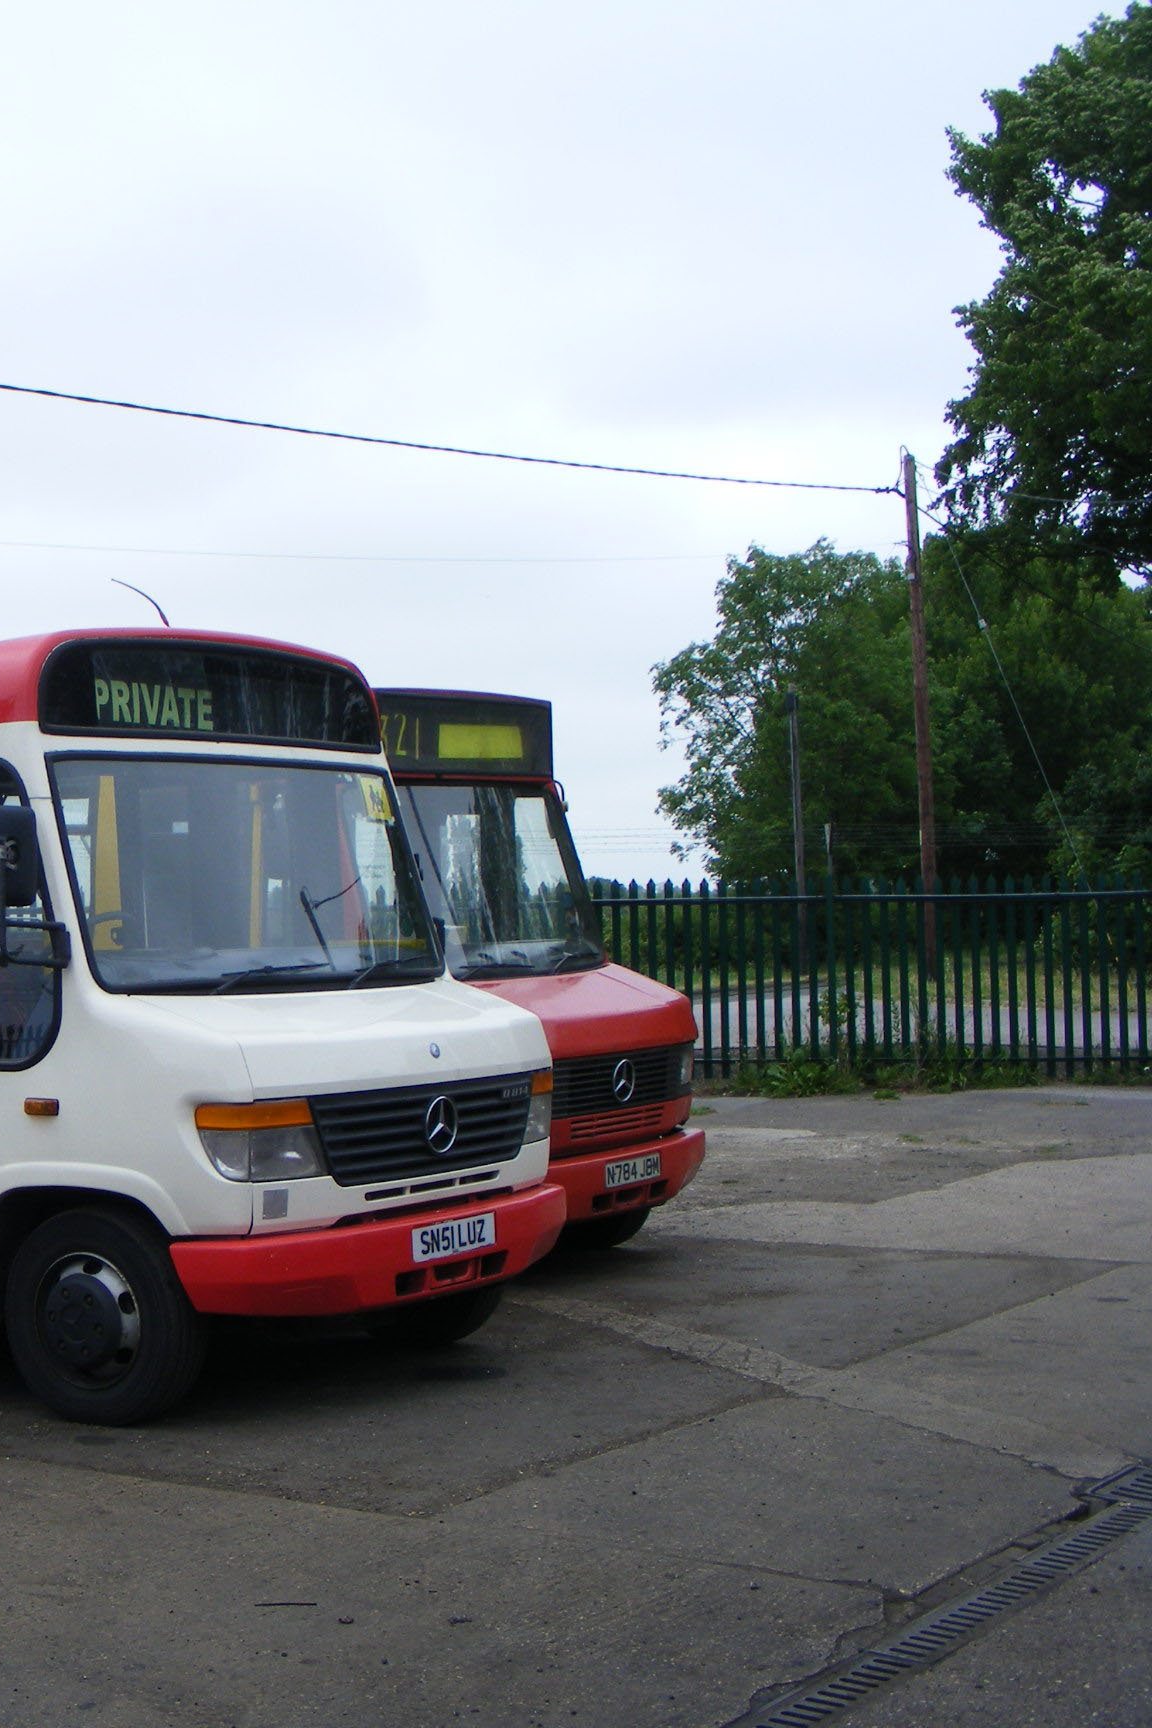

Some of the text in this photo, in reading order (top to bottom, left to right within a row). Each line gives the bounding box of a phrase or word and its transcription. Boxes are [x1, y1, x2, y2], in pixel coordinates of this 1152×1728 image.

[94, 678, 214, 731] PRIVATE
[607, 1161, 638, 1185] N784
[420, 1218, 486, 1255] SN51 LUZ
